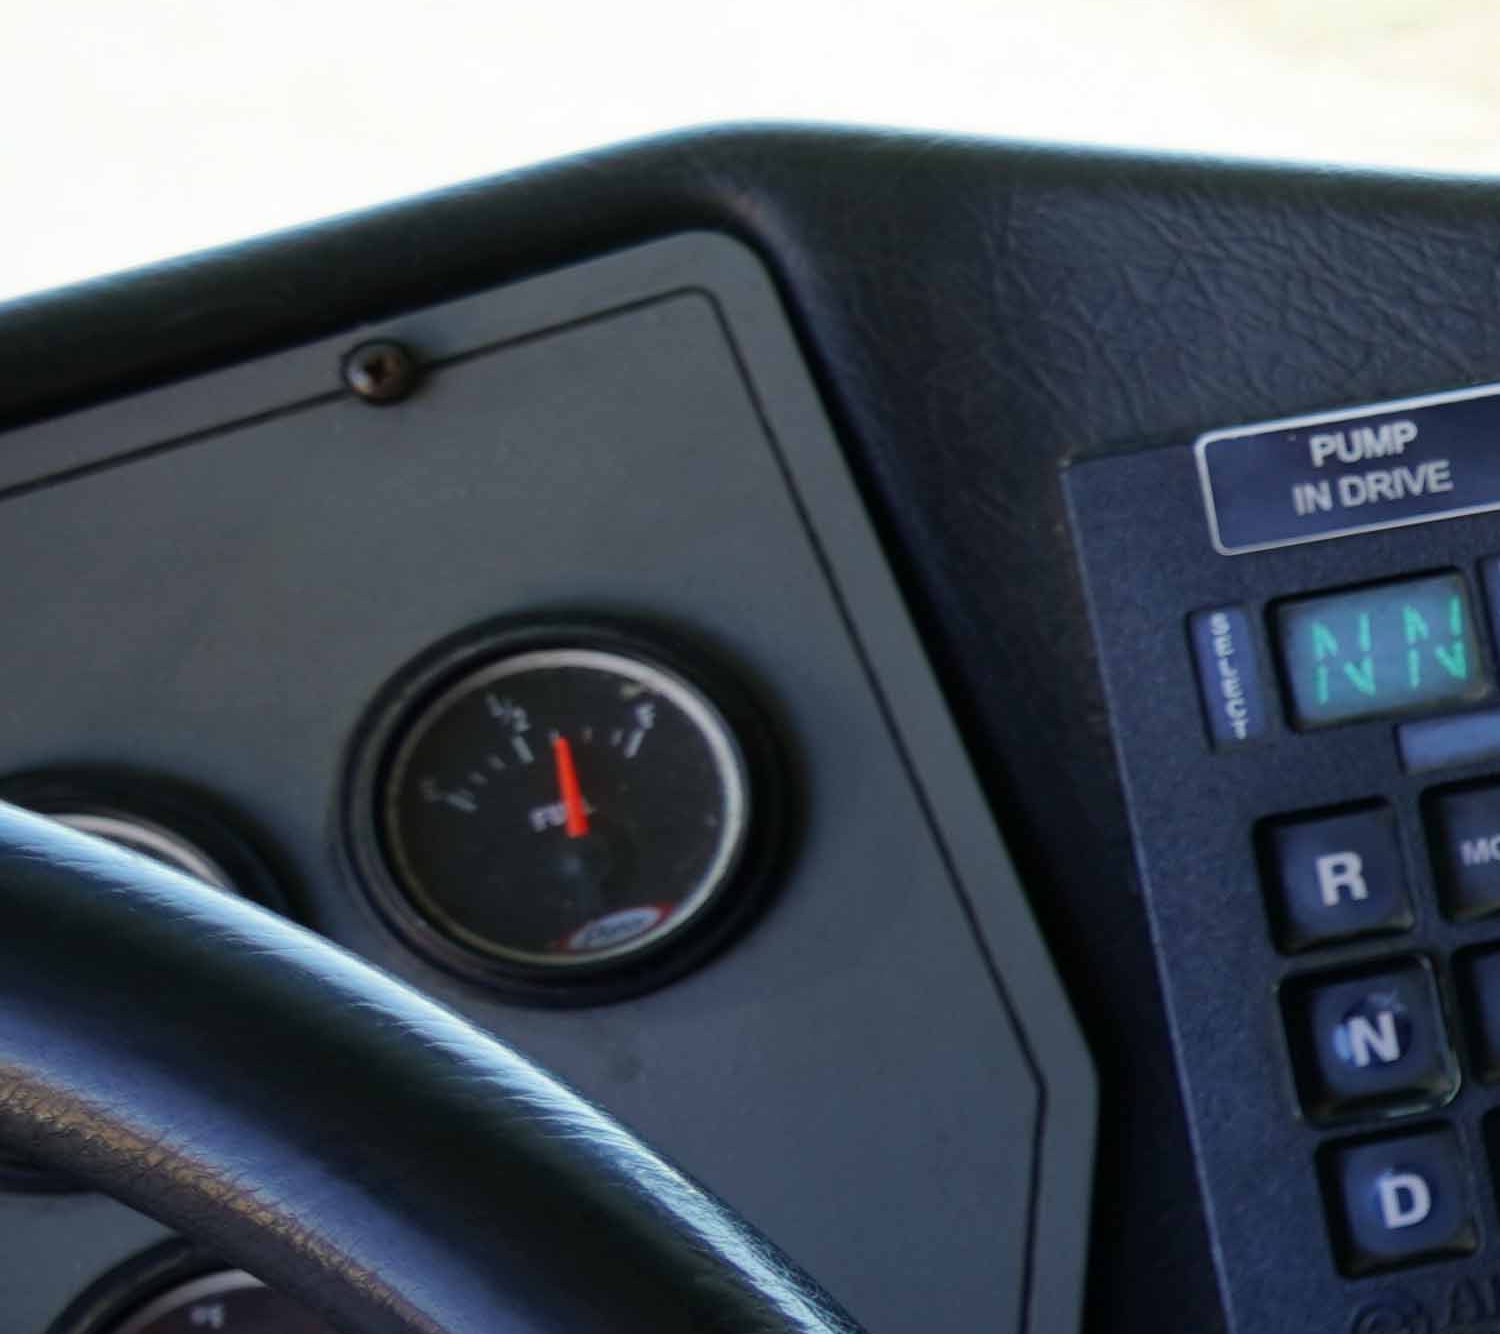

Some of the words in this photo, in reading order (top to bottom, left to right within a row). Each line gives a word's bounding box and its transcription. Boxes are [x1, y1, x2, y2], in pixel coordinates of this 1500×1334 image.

[1309, 420, 1418, 467] PUMP
[1292, 480, 1333, 516] IN
[1338, 460, 1454, 509] DRIVE
[1210, 612, 1249, 740] SELECT
[527, 796, 599, 833] FUL
[1314, 851, 1369, 906] R
[1350, 1011, 1400, 1068] N
[1377, 1173, 1432, 1229] D
